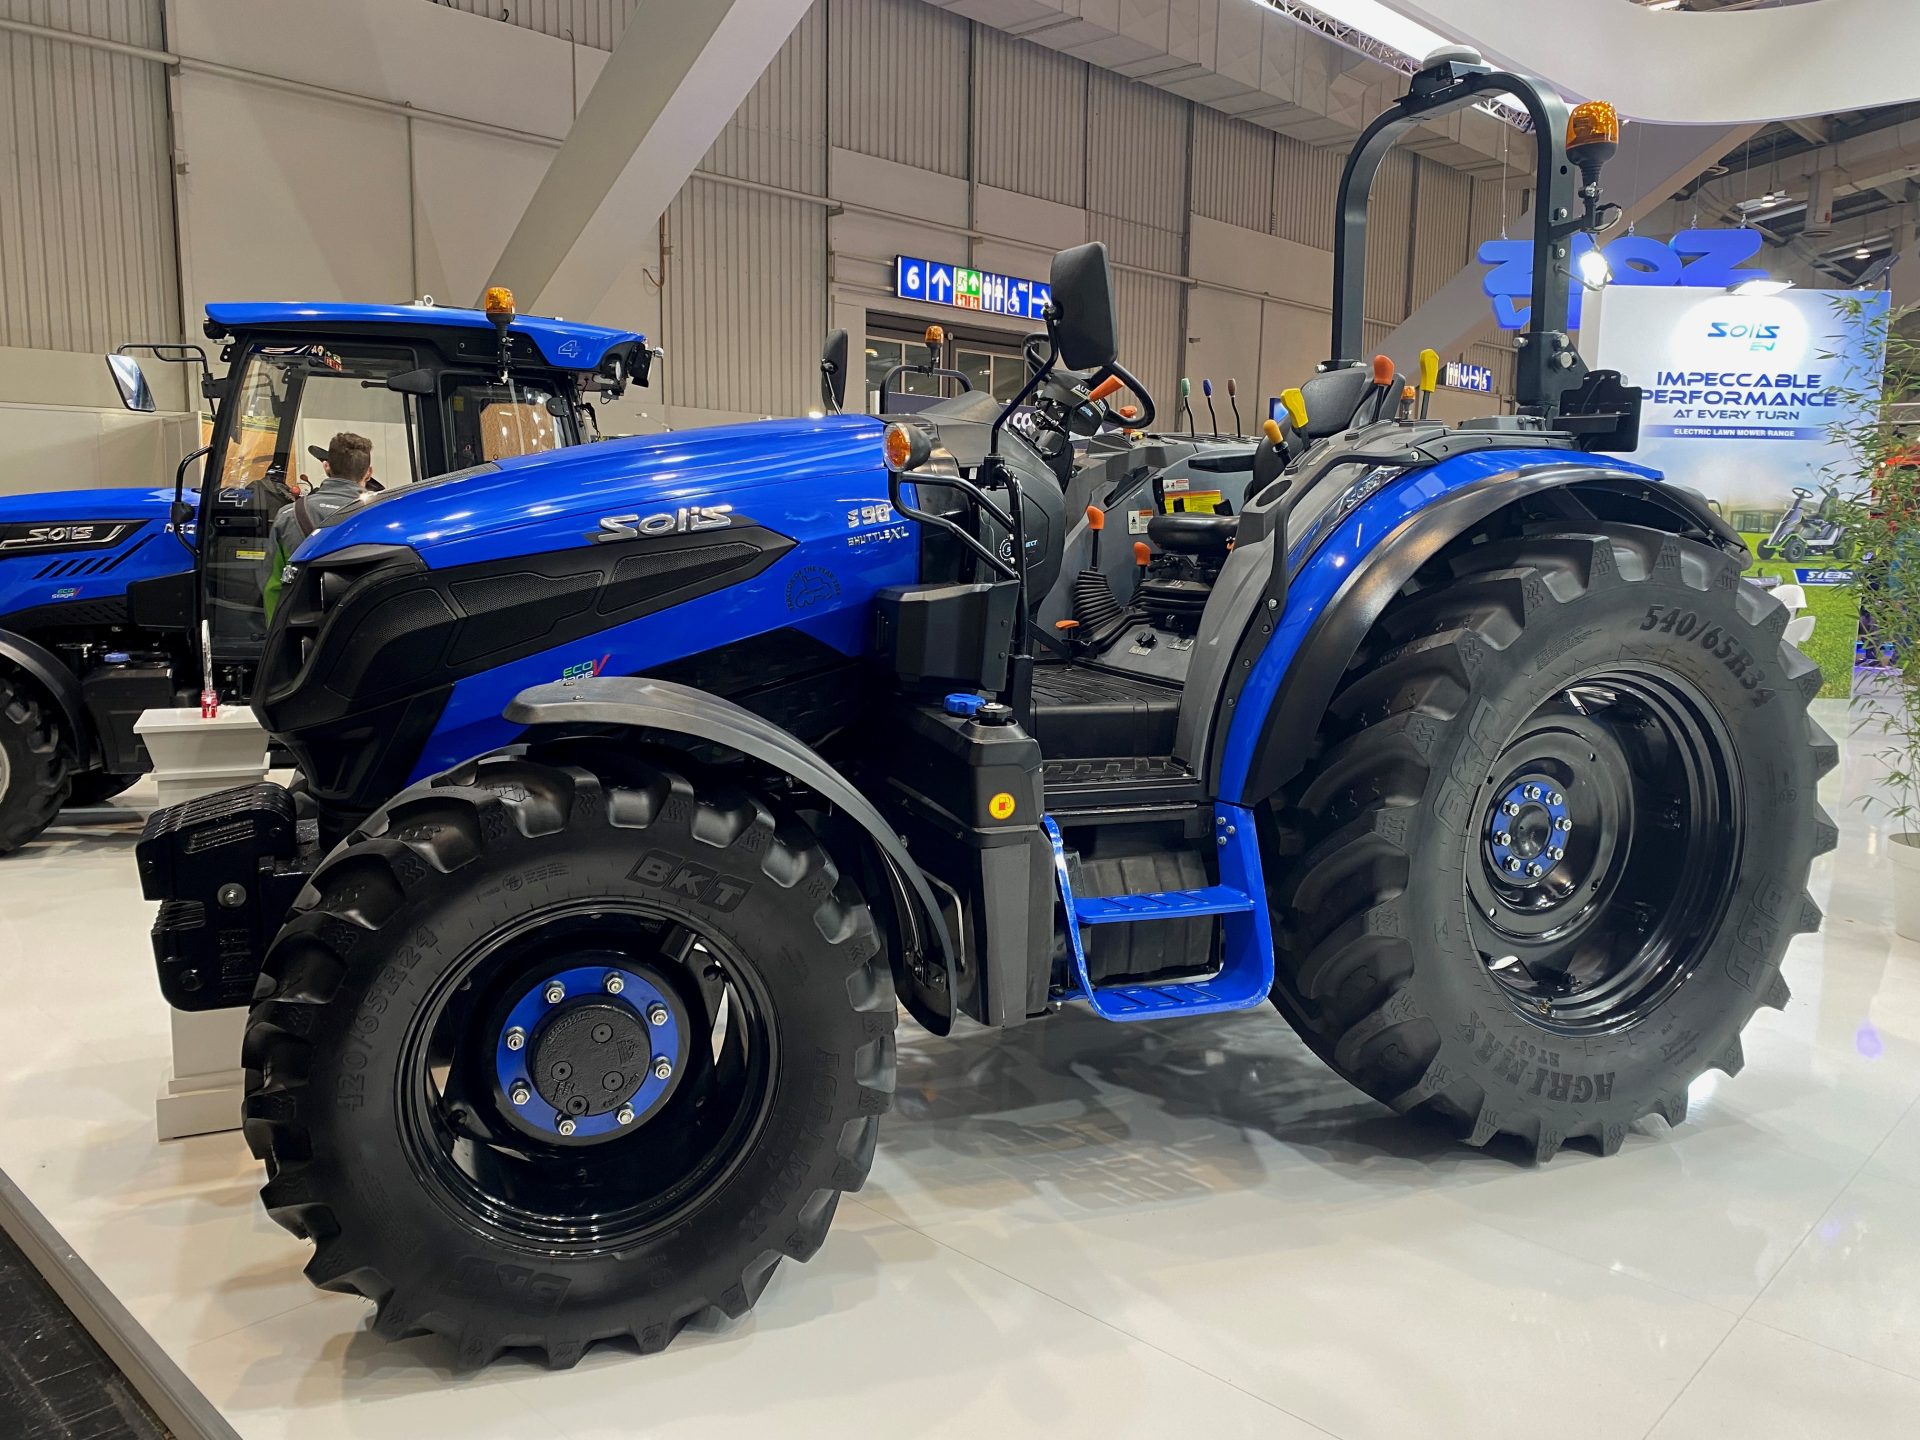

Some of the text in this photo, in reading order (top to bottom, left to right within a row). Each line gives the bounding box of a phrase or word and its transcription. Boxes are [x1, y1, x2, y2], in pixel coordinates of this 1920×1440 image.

[906, 265, 920, 290] 6
[1018, 282, 1029, 293] WC
[1657, 372, 1822, 389] IMPECCABLE
[1641, 389, 1838, 406] PERFORMANCE
[1673, 409, 1800, 420] AT EVERY TURN
[1674, 428, 1711, 436] ELECTRIC
[1640, 603, 1777, 708] 540/65R34
[563, 660, 593, 677] ECO
[635, 854, 747, 907] BKT
